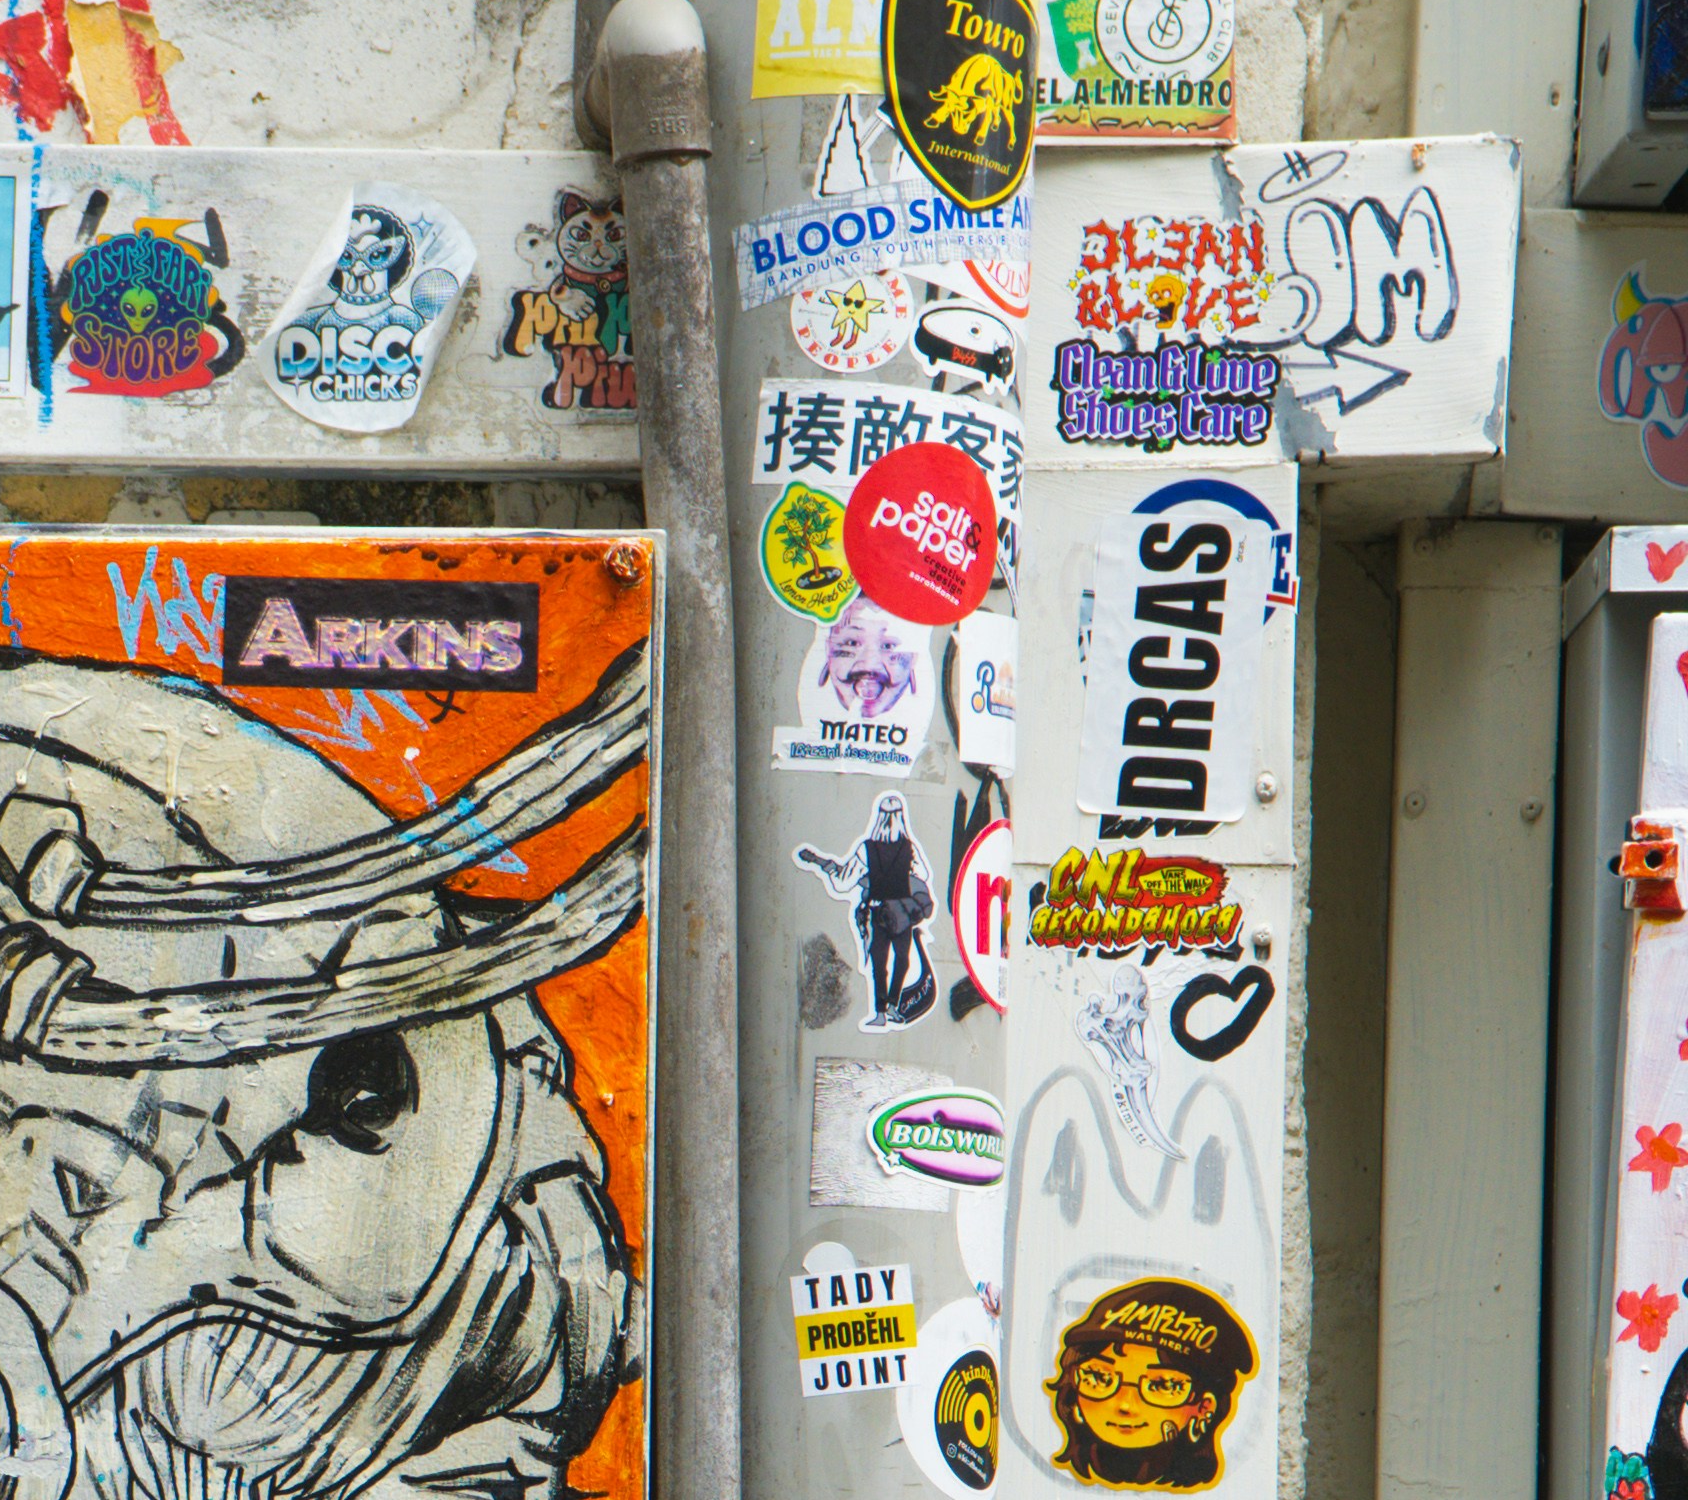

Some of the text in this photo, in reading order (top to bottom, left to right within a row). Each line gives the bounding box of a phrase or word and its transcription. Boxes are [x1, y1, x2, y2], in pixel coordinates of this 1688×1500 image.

[1036, 78, 1232, 107] EL ALMENDRO
[927, 140, 1012, 176] International
[752, 205, 897, 275] BLOOD
[767, 251, 862, 287] BANDUNG
[872, 238, 934, 258] YOUTH
[70, 313, 203, 385] STORE
[277, 325, 424, 379] DISC
[797, 325, 897, 369] PEOPLE
[312, 374, 419, 401] CHICKS
[870, 496, 978, 573] paper
[913, 491, 971, 538] salt
[923, 554, 966, 587] creative
[929, 568, 963, 596] design
[239, 597, 523, 673] ARKINS
[1116, 522, 1233, 811] DRCAS
[1161, 868, 1187, 880] VANS
[1164, 879, 1182, 892] THE
[804, 1267, 897, 1312] TADY
[807, 1311, 905, 1350] PROBĚHL
[1124, 1330, 1191, 1355] WAS HERE
[813, 1353, 908, 1393] JOINT
